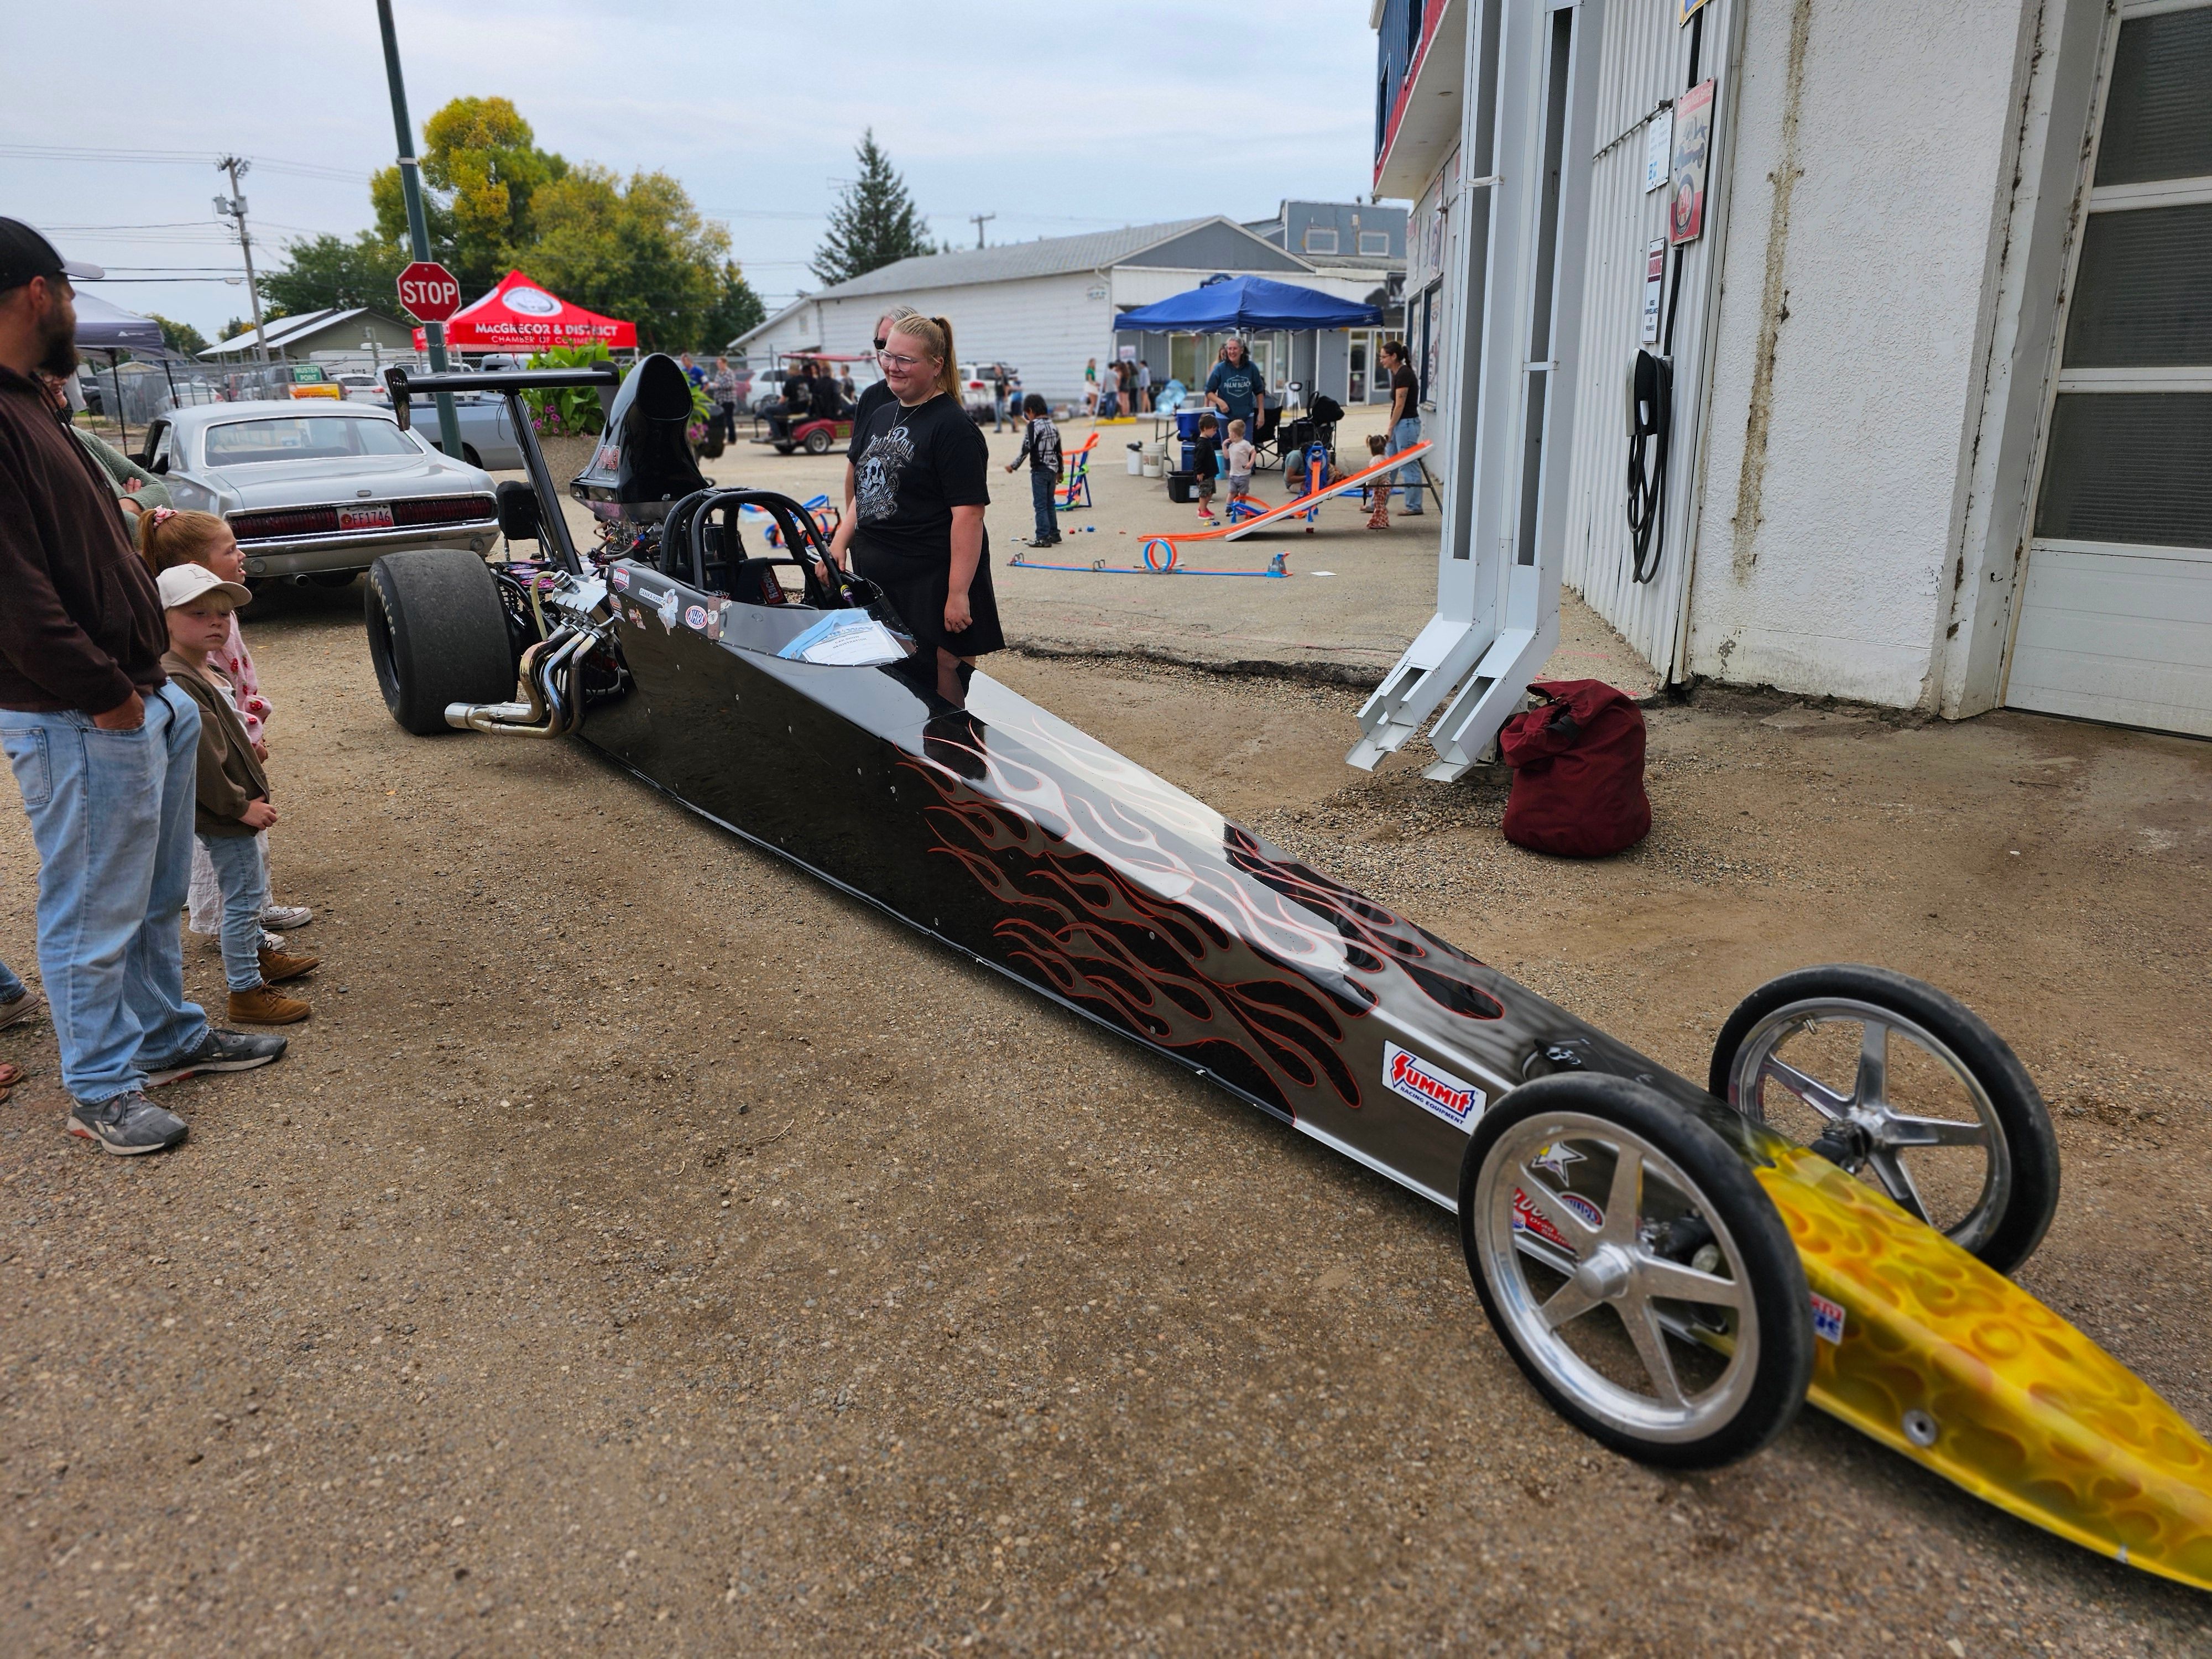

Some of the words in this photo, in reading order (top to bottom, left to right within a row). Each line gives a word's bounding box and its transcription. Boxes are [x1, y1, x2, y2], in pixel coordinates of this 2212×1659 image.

[403, 280, 456, 304] STOP
[554, 324, 562, 335] &
[565, 325, 618, 337] DISTRICT
[491, 335, 535, 343] CHAMBER
[539, 336, 550, 344] OF
[892, 426, 915, 463] ROLL
[352, 511, 390, 524] FF1746
[688, 609, 705, 625] NHRA
[1400, 1086, 1424, 1103] RACING
[1425, 1100, 1465, 1125] EQUIPMENT
[1530, 1217, 1554, 1233] Drag
